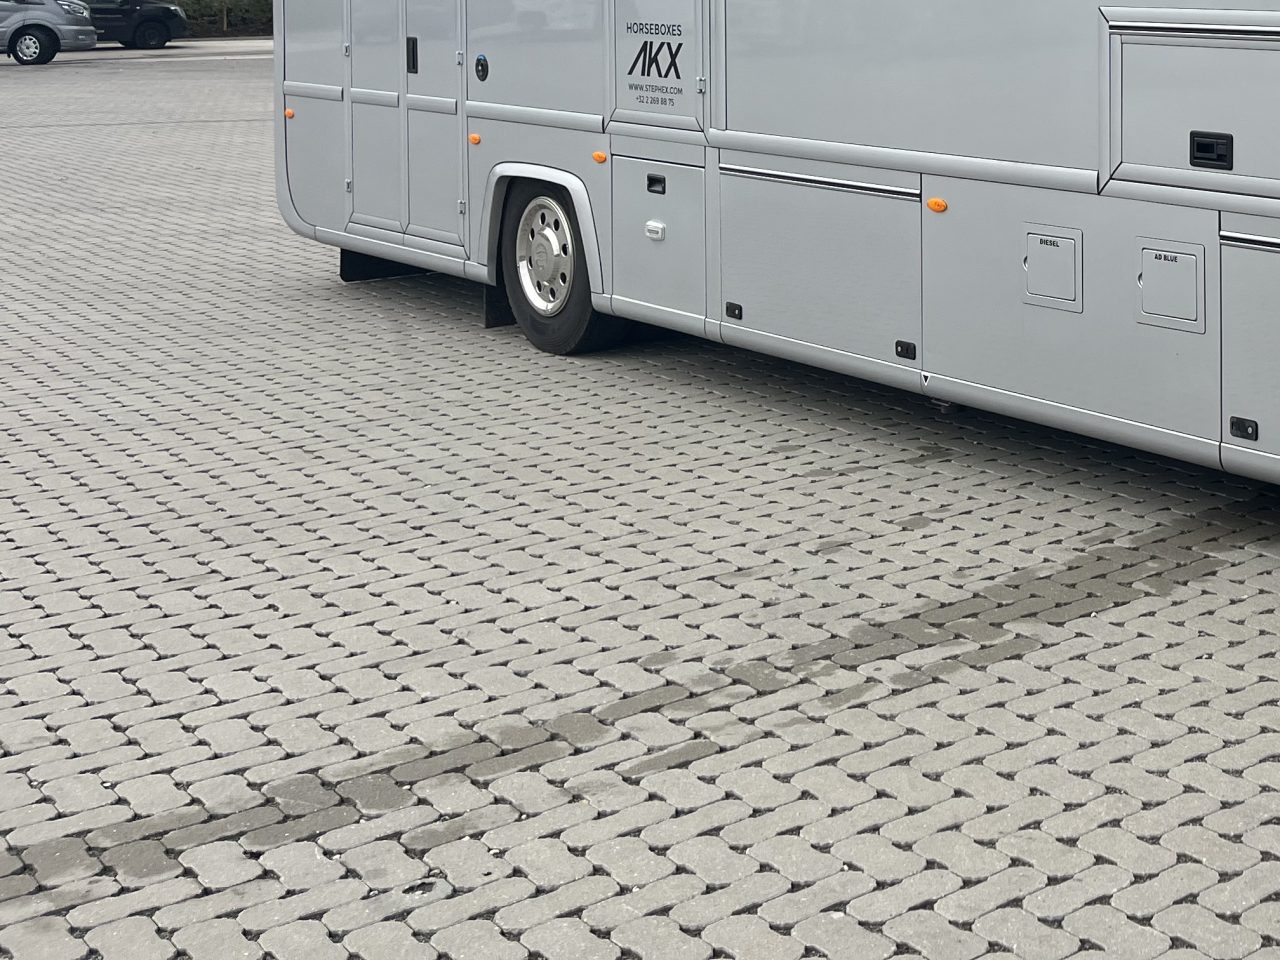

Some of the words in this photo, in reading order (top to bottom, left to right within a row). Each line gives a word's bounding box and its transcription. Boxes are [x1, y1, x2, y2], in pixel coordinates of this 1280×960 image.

[626, 22, 682, 36] HORSEBOXES
[627, 40, 684, 80] AKX
[628, 83, 683, 95] WWW.STEPHEX.COM
[636, 95, 645, 104] +32
[668, 98, 675, 107] 75
[1039, 238, 1060, 248] DIESEL
[1154, 253, 1162, 261] AD
[1163, 254, 1178, 262] BLUE
